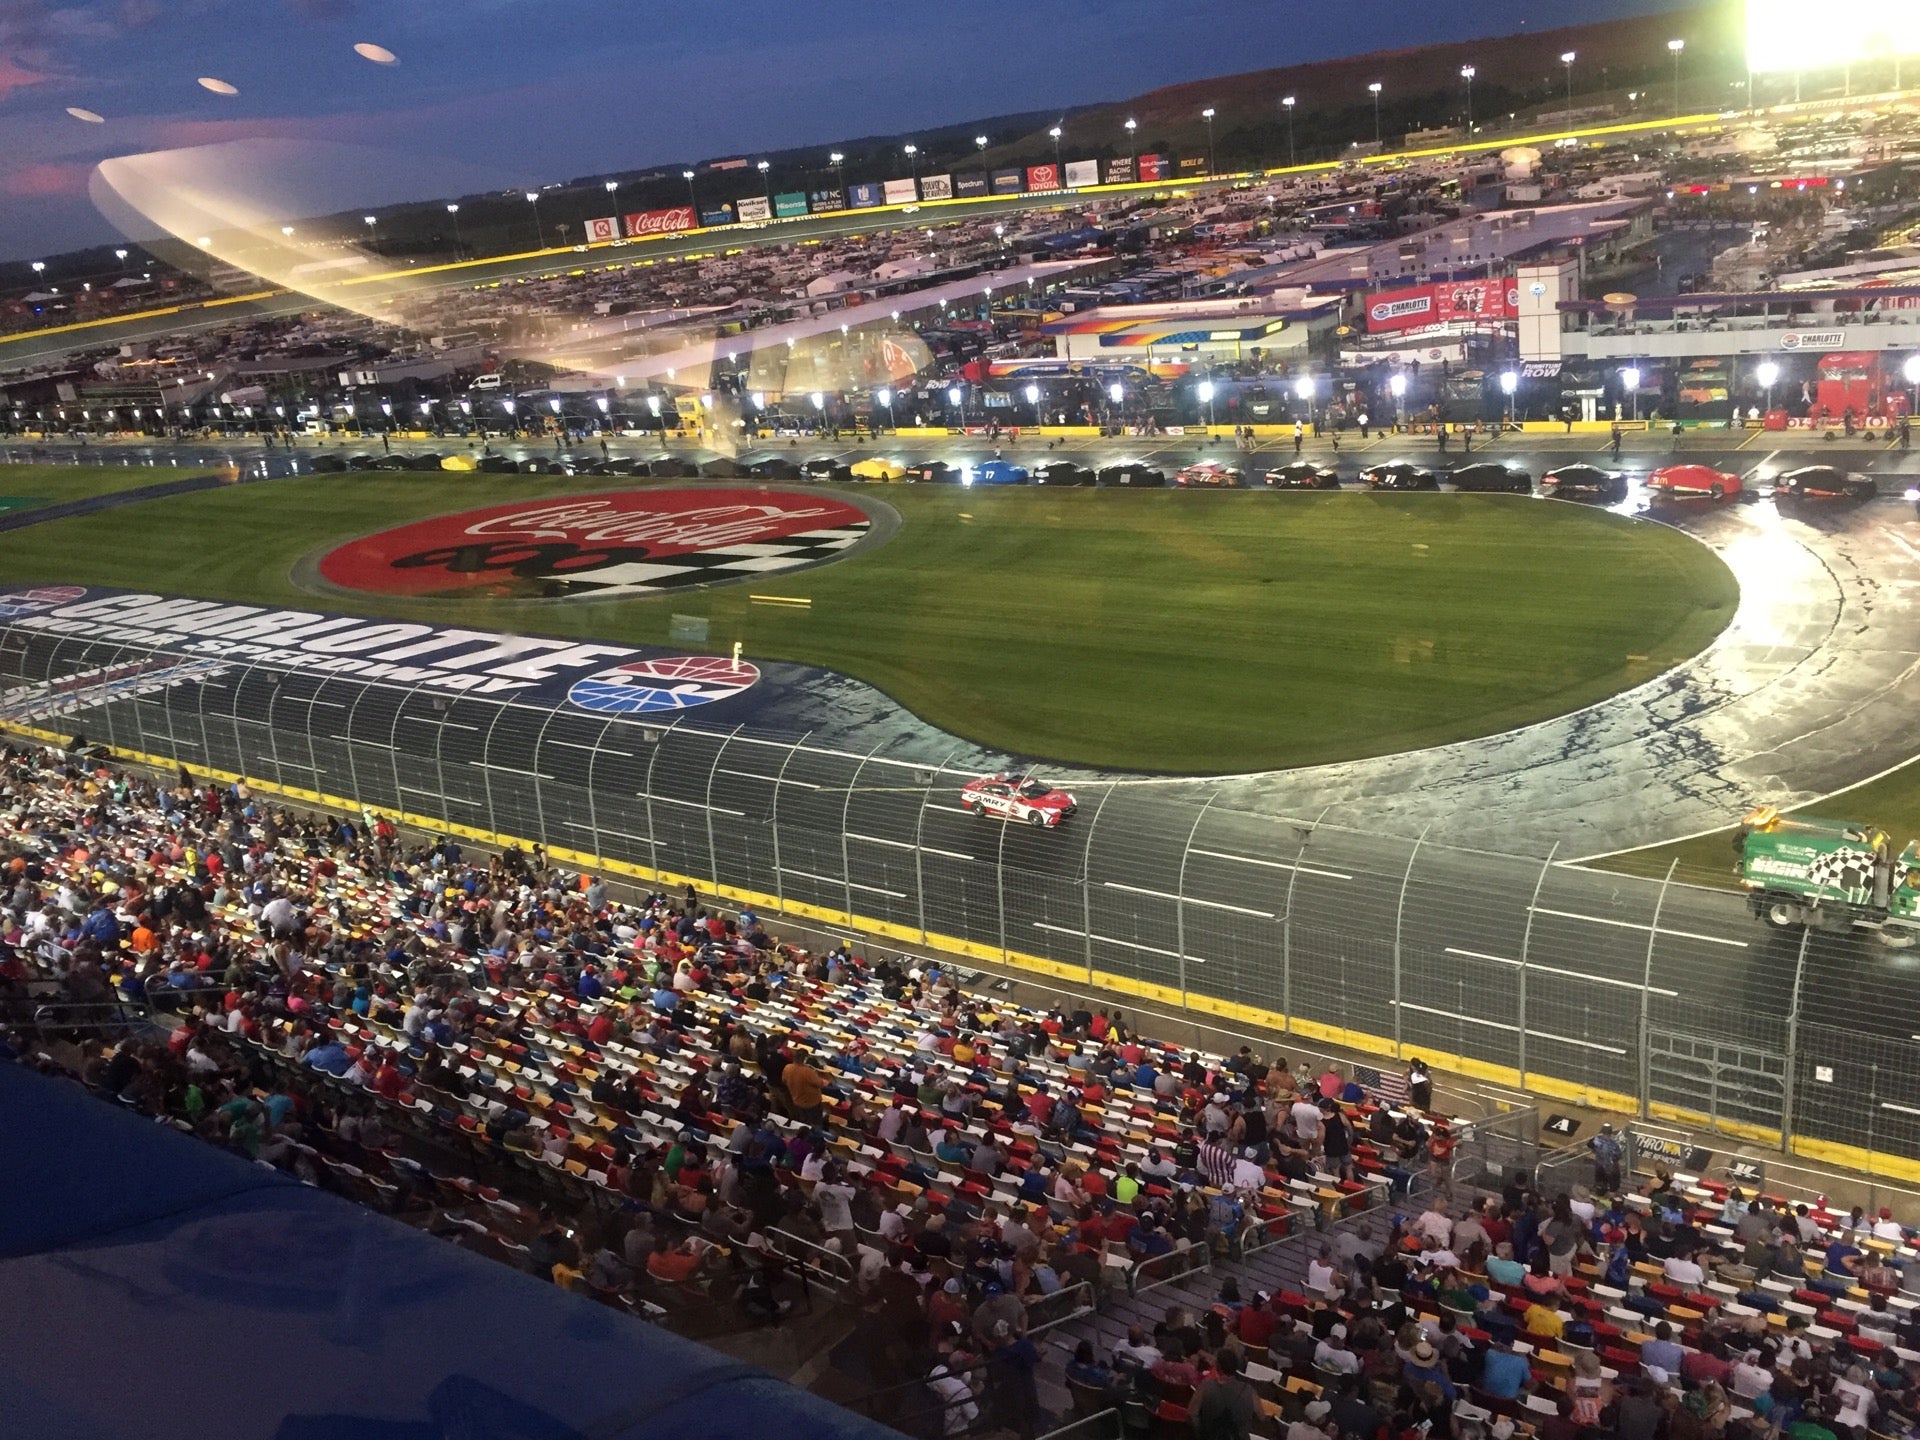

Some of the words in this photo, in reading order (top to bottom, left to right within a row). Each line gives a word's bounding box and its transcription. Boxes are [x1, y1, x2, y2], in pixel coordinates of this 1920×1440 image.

[1112, 158, 1132, 167] WHERE
[1108, 166, 1131, 175] RACING
[957, 180, 984, 189] Spectrum
[1029, 181, 1059, 190] TOYOTA
[829, 190, 841, 198] NC
[776, 201, 807, 210] Hisense
[635, 208, 691, 235] Coca-Cola
[1391, 299, 1428, 312] CHARLOTTE
[1801, 334, 1843, 343] CHARLOTTE
[1521, 369, 1560, 378] ROW
[985, 470, 995, 480] 17
[1199, 472, 1213, 482] 77
[1359, 472, 1379, 482] FedEx
[1384, 474, 1398, 484] 11
[464, 500, 847, 545] Coca-Cola
[50, 594, 642, 679] CHARLOTTE
[9, 616, 189, 646] MOTOR
[181, 639, 543, 693] SPEEDWAY
[968, 792, 1006, 807] CAMRY
[1551, 1118, 1569, 1132] A
[1652, 1152, 1681, 1168] REMOVE
